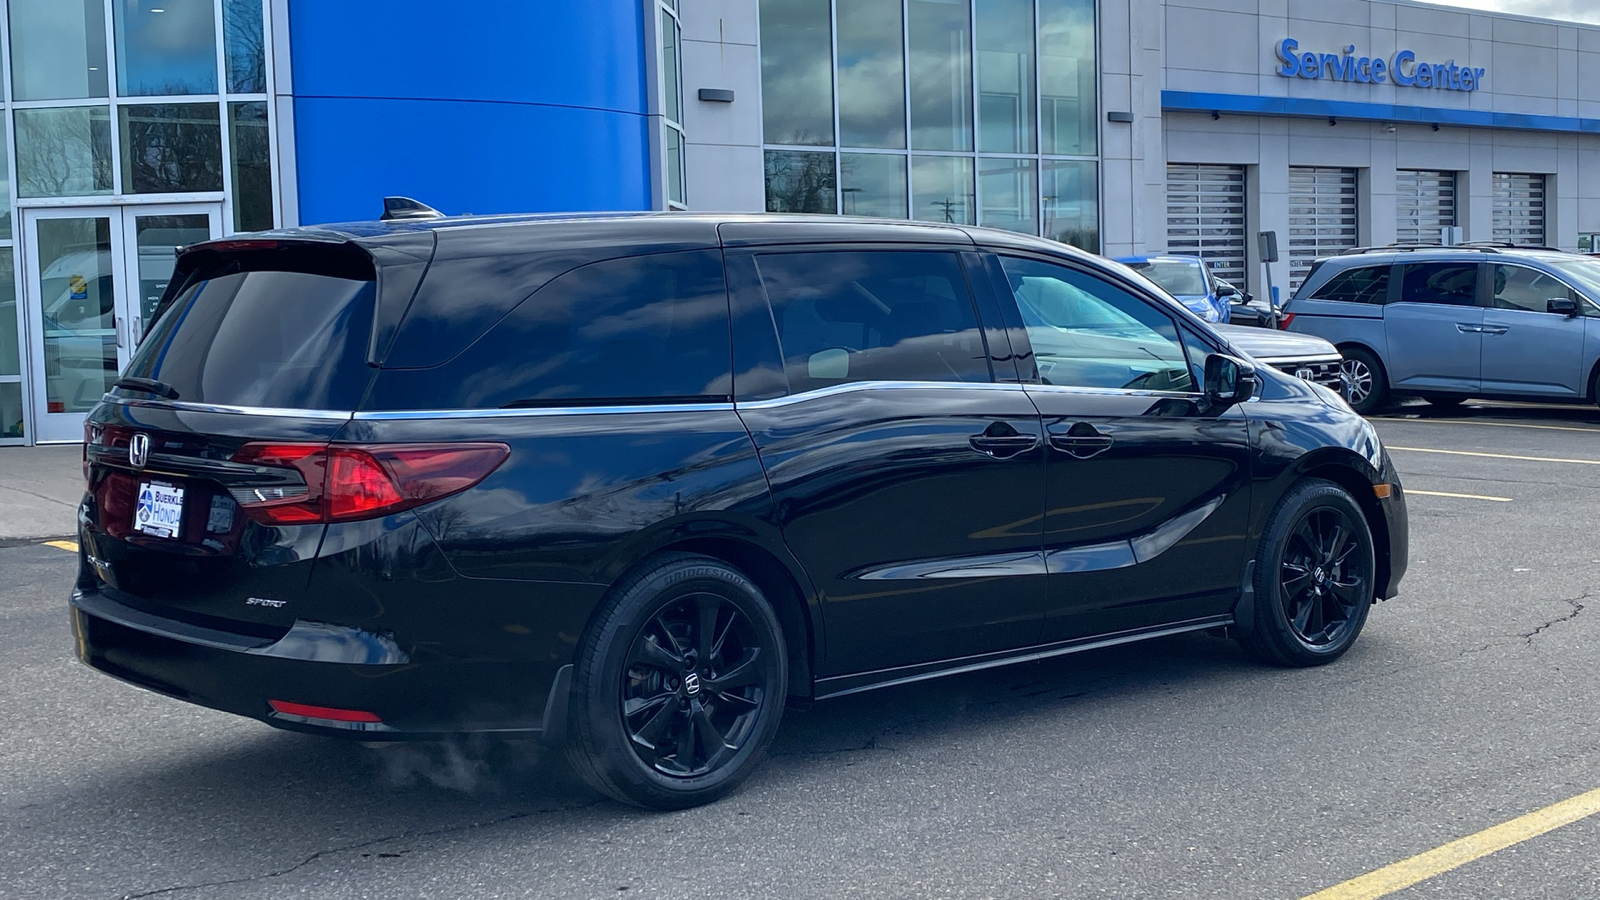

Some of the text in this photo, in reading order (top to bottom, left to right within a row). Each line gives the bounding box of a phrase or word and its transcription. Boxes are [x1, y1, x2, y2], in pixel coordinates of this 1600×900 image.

[1276, 38, 1486, 92] Service Center
[155, 491, 184, 506] BUERKLE
[153, 503, 180, 524] HONDA
[664, 567, 750, 588] BRIDGESTONE
[245, 597, 287, 608] SPORT
